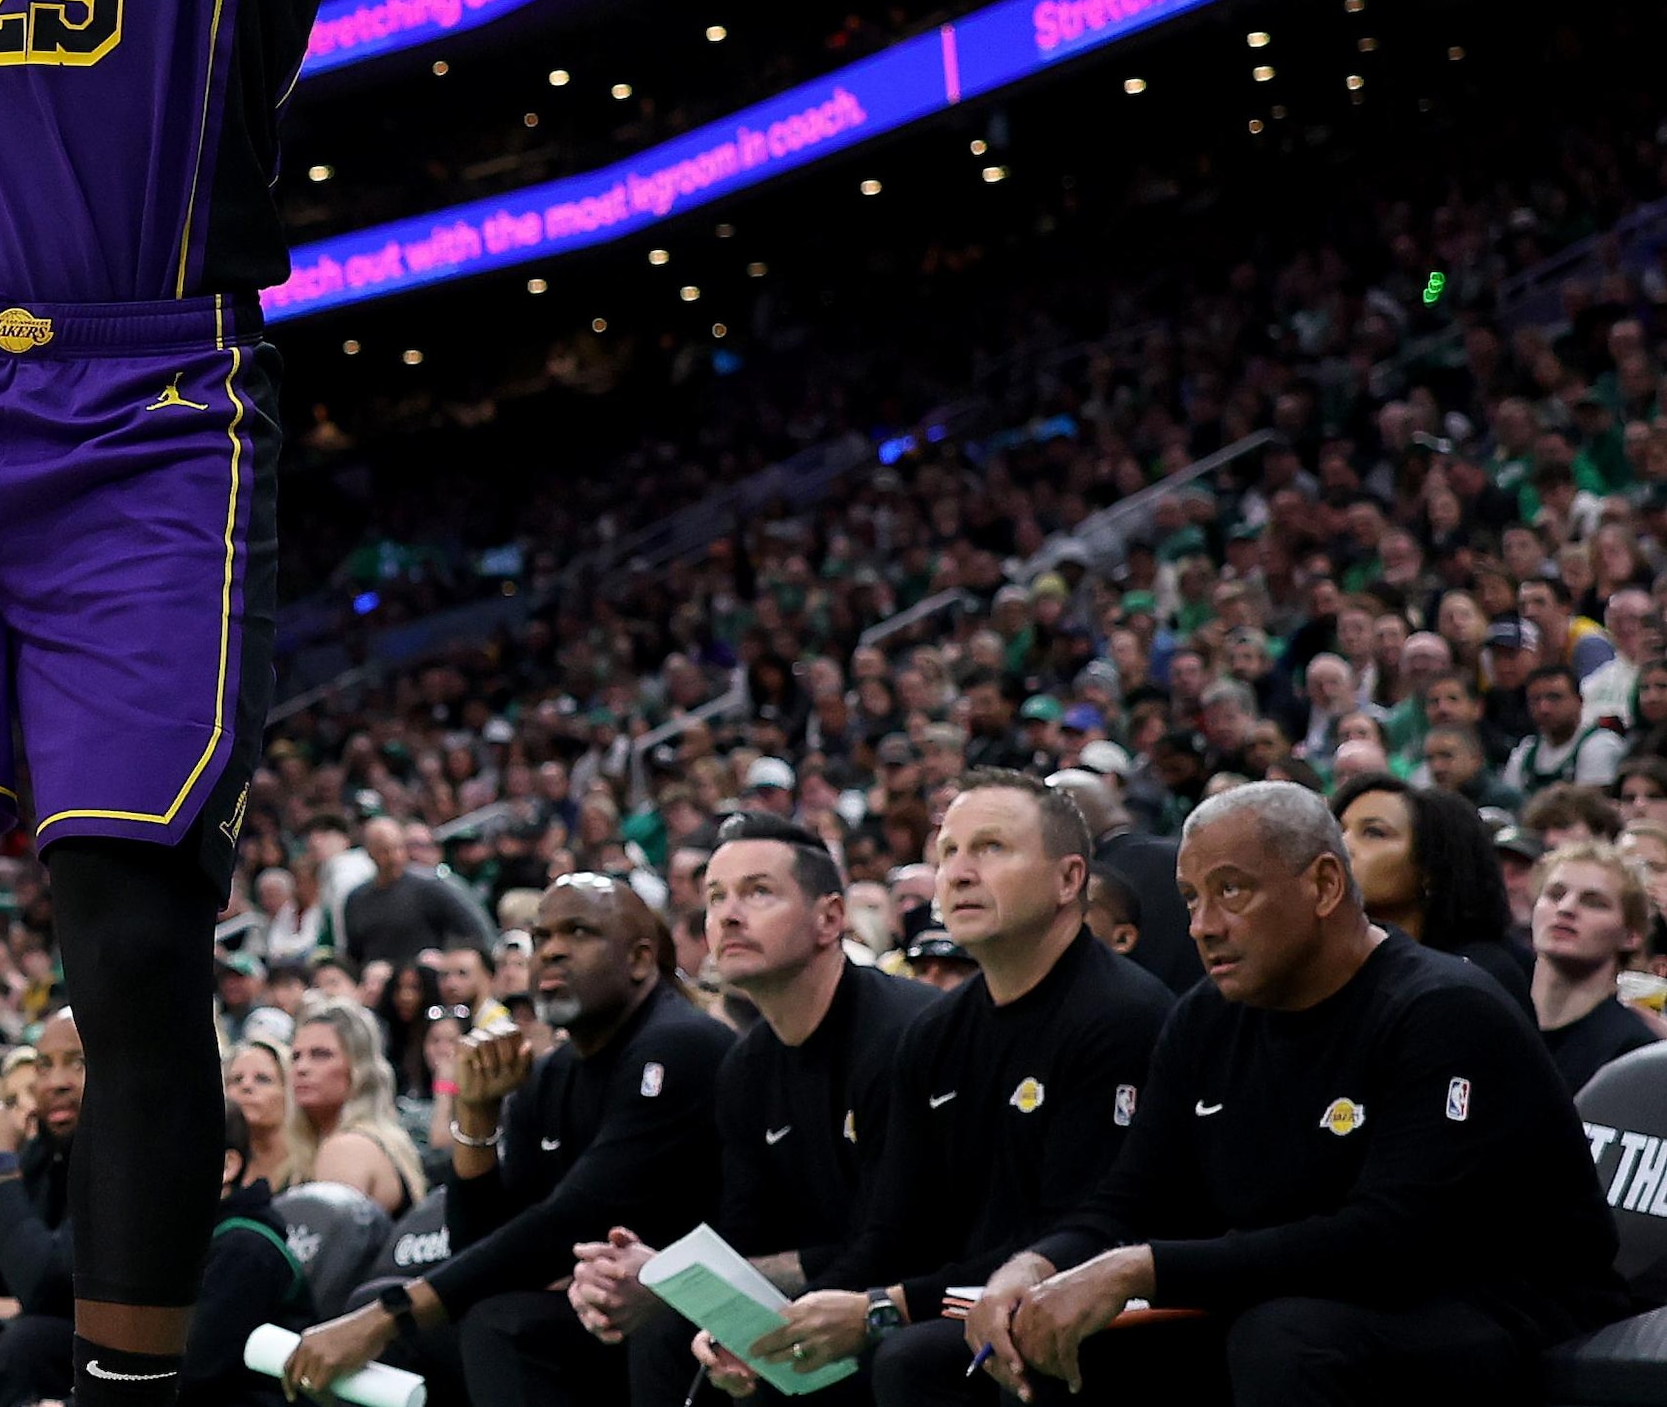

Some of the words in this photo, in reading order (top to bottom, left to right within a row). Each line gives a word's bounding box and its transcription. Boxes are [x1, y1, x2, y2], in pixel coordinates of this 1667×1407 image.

[345, 241, 403, 286] out
[405, 221, 481, 271] with
[482, 210, 543, 254] the
[545, 184, 629, 240] most
[737, 125, 768, 167] in
